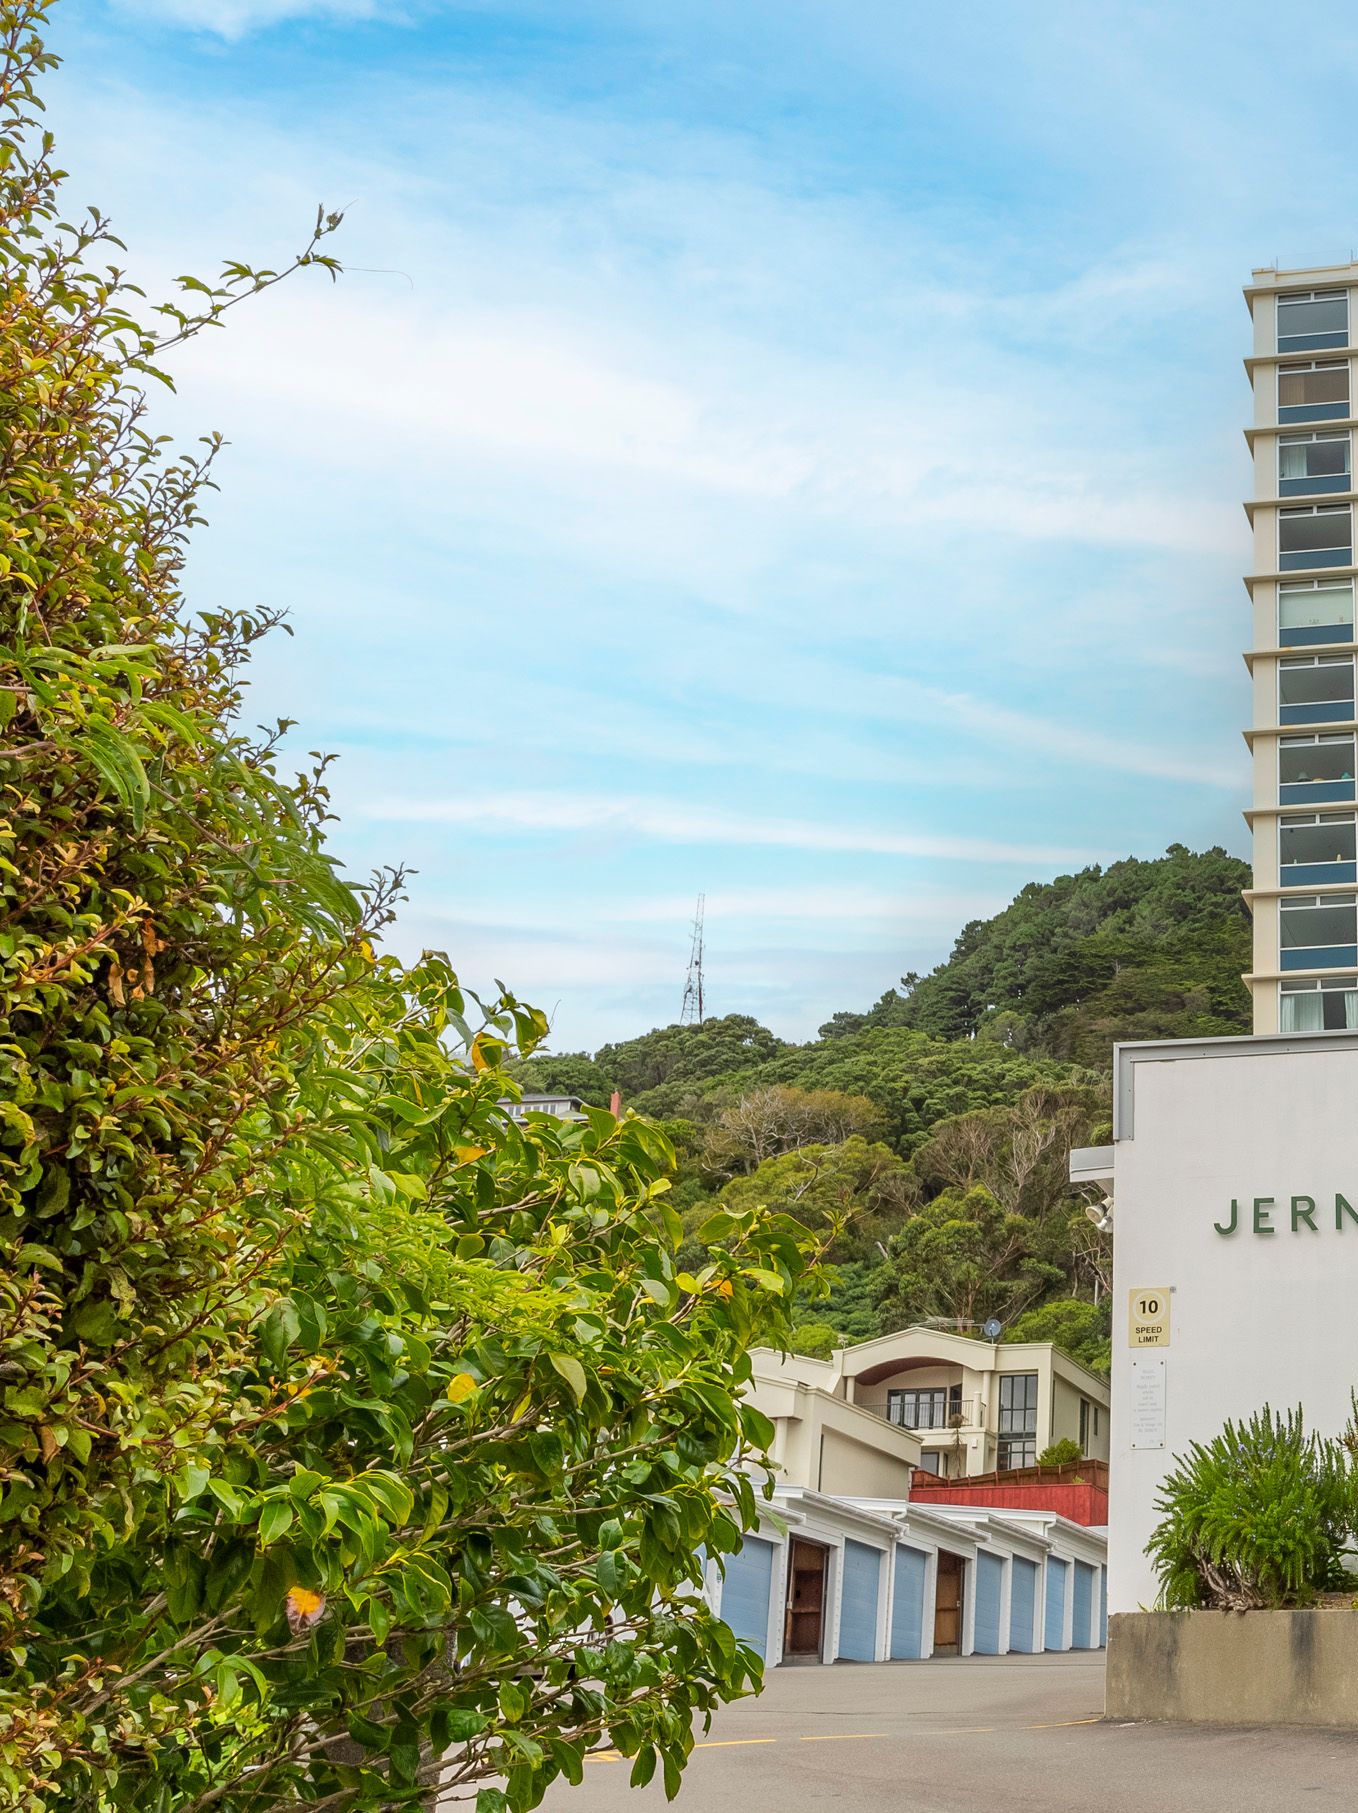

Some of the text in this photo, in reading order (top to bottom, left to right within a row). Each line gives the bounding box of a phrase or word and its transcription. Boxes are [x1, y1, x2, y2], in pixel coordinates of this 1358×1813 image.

[1139, 1300, 1158, 1314] 10
[1135, 1326, 1162, 1334] SPEED
[1138, 1335, 1159, 1343] LIMIT
